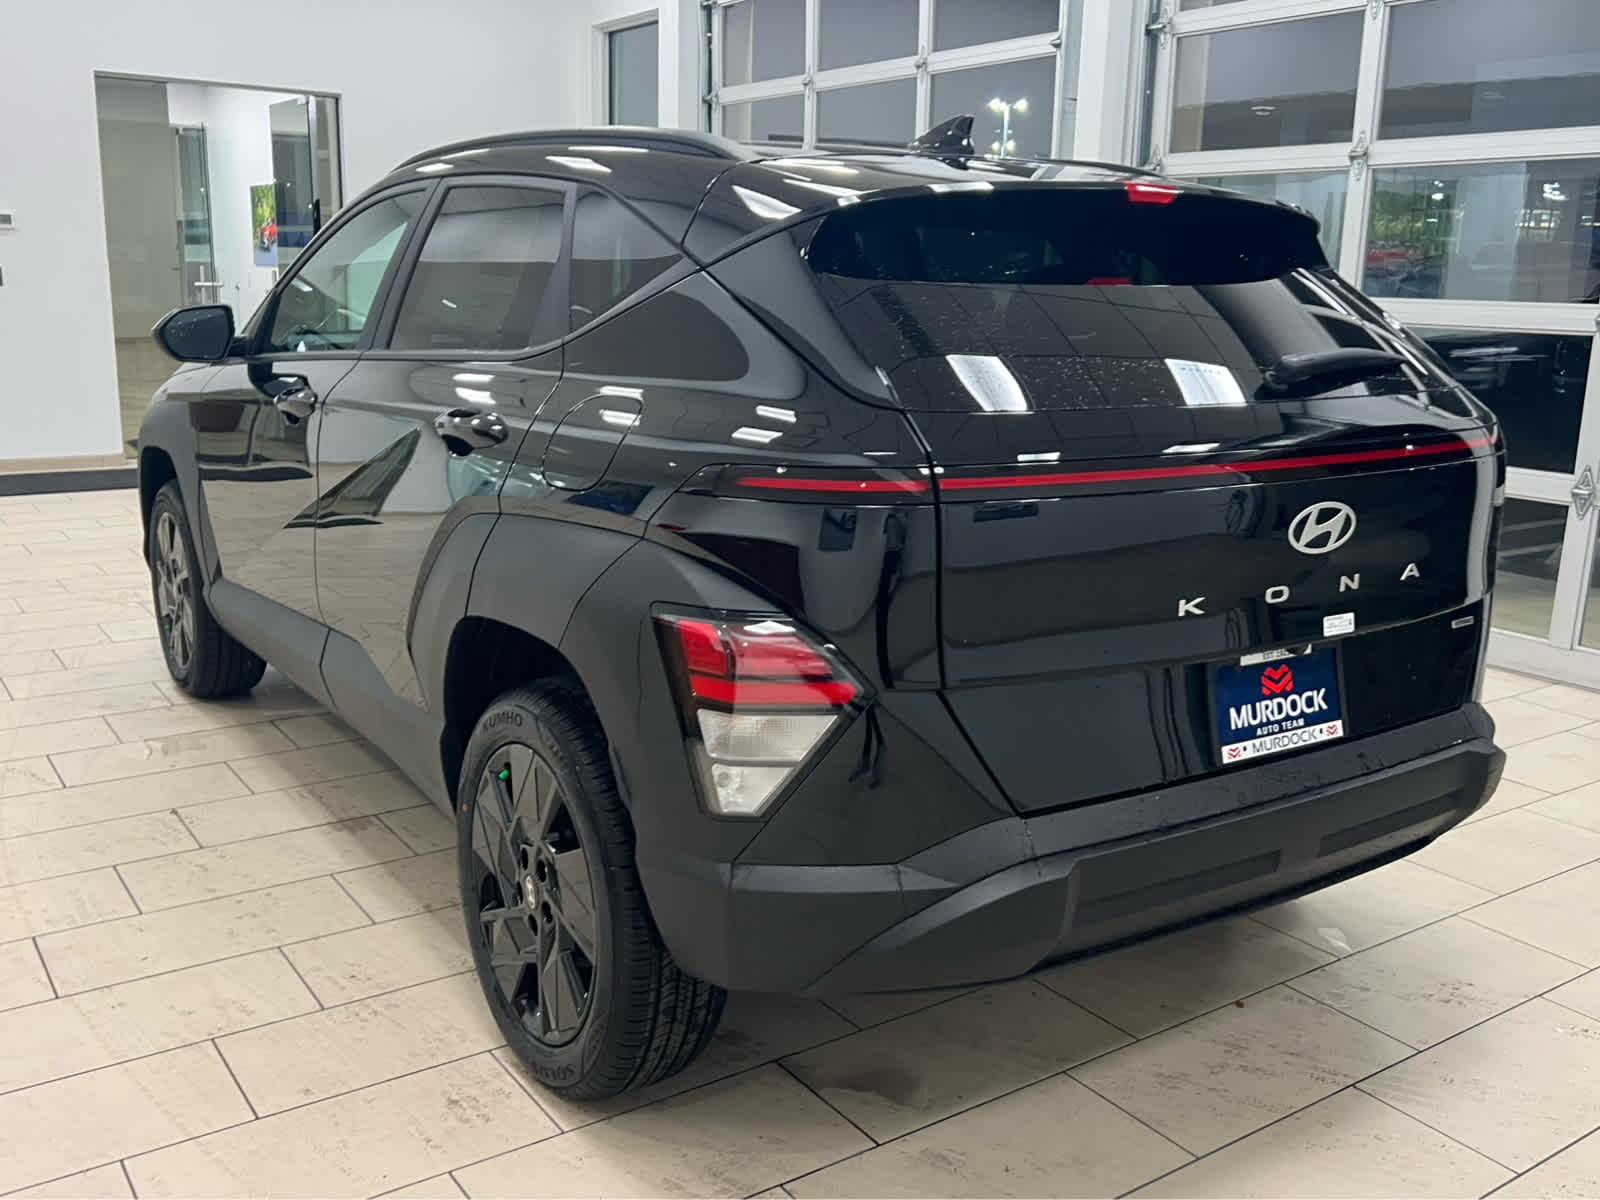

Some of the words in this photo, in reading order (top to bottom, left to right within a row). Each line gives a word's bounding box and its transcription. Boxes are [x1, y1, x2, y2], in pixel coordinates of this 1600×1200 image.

[1178, 563, 1420, 617] KONA
[1229, 687, 1328, 730] MURDOCK
[1252, 727, 1318, 754] MURDOCK
[1256, 724, 1280, 736] AUTO
[1282, 718, 1305, 733] TEAM
